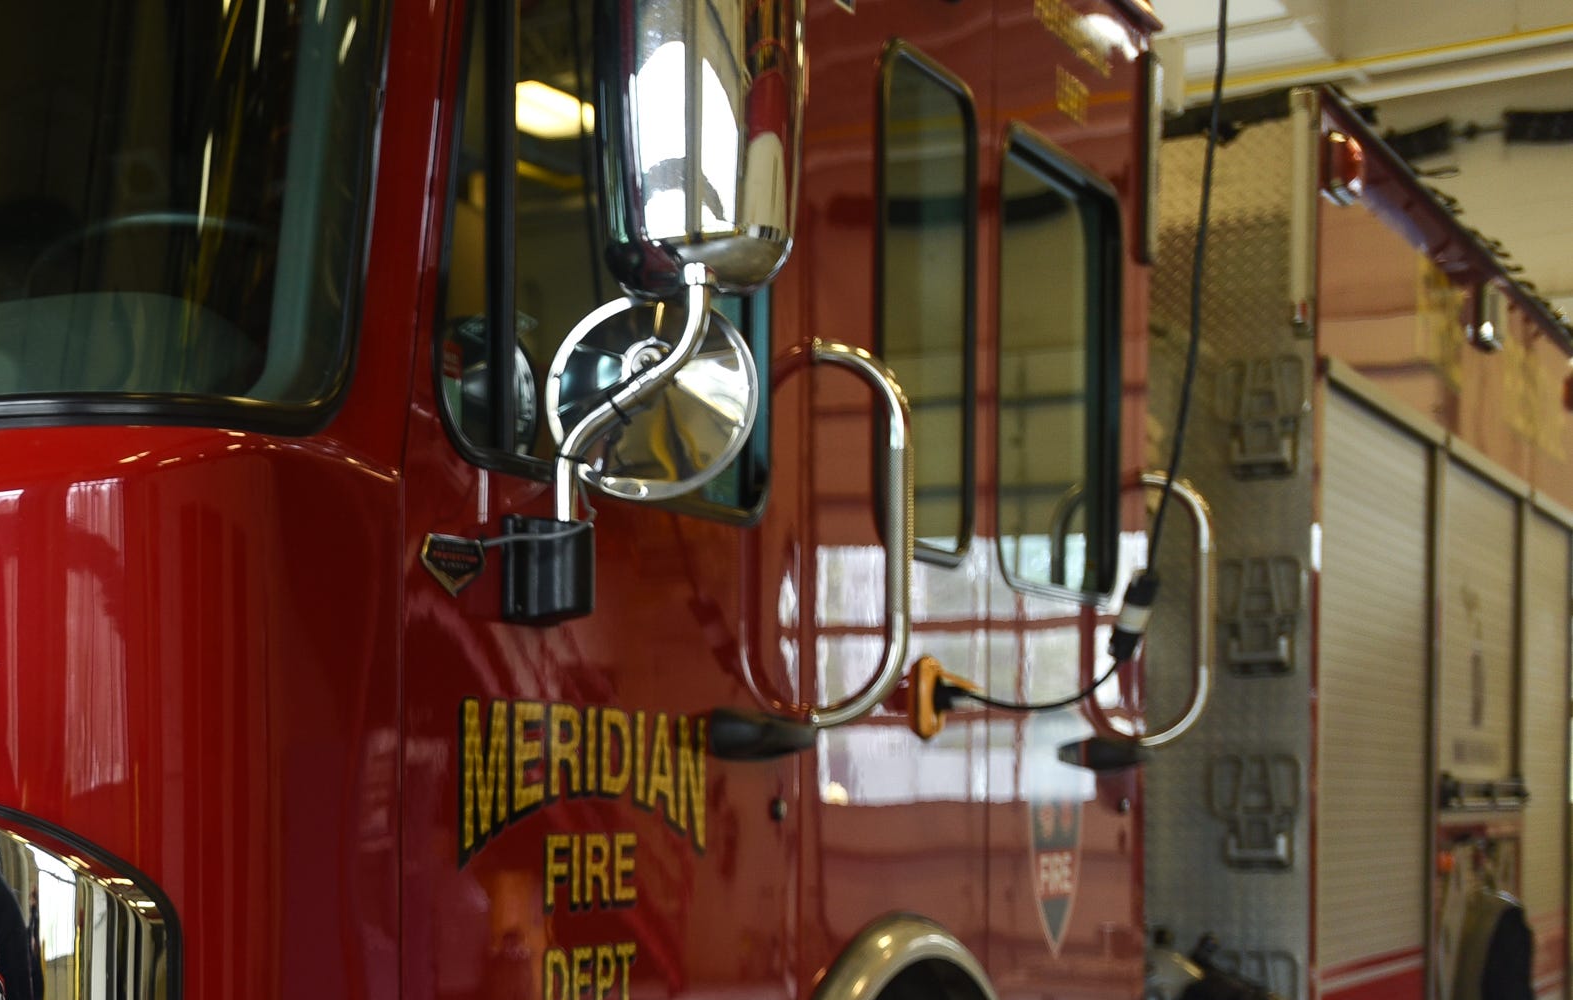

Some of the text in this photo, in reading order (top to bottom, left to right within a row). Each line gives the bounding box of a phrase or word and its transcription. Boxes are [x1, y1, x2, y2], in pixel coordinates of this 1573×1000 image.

[460, 698, 706, 860] MERIDIAN
[545, 834, 637, 910] FIRE
[1039, 852, 1073, 895] FIRE
